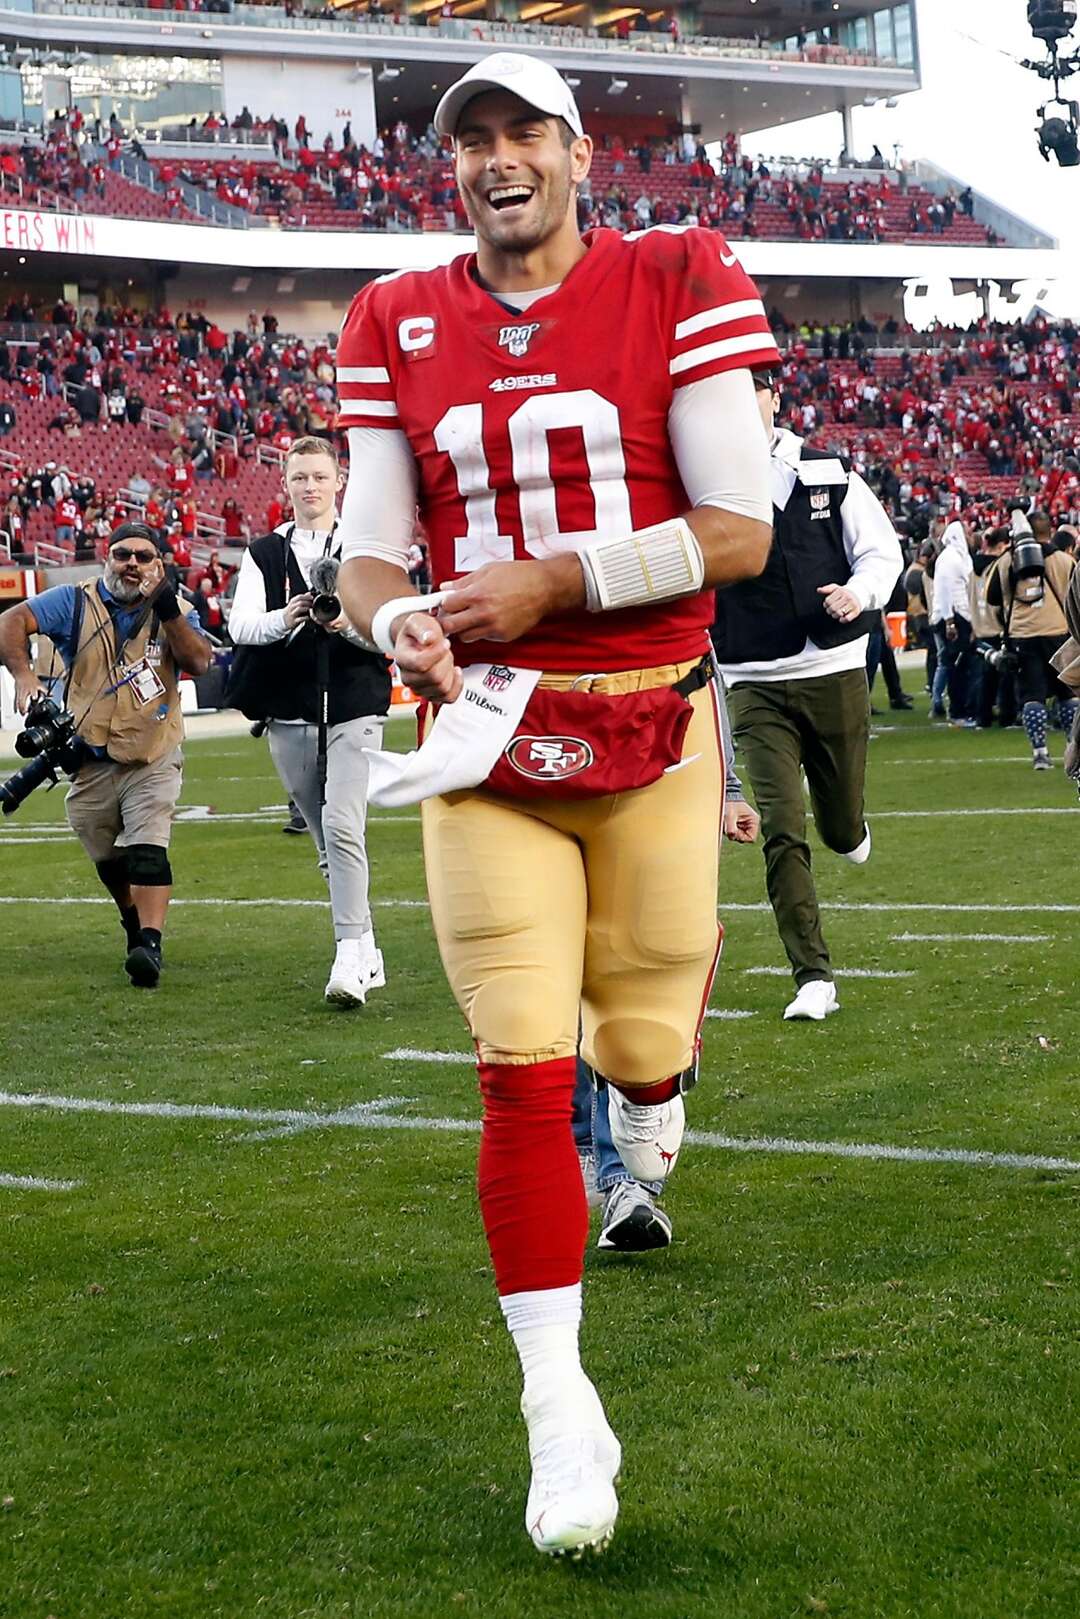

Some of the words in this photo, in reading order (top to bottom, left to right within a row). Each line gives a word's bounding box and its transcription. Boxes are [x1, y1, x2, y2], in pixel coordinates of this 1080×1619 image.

[54, 216, 95, 253] WIN
[399, 316, 435, 352] C
[488, 373, 558, 392] 49ERS
[433, 389, 635, 573] 10
[484, 674, 507, 692] NFL
[464, 688, 504, 716] Wilson
[529, 741, 577, 773] SF
